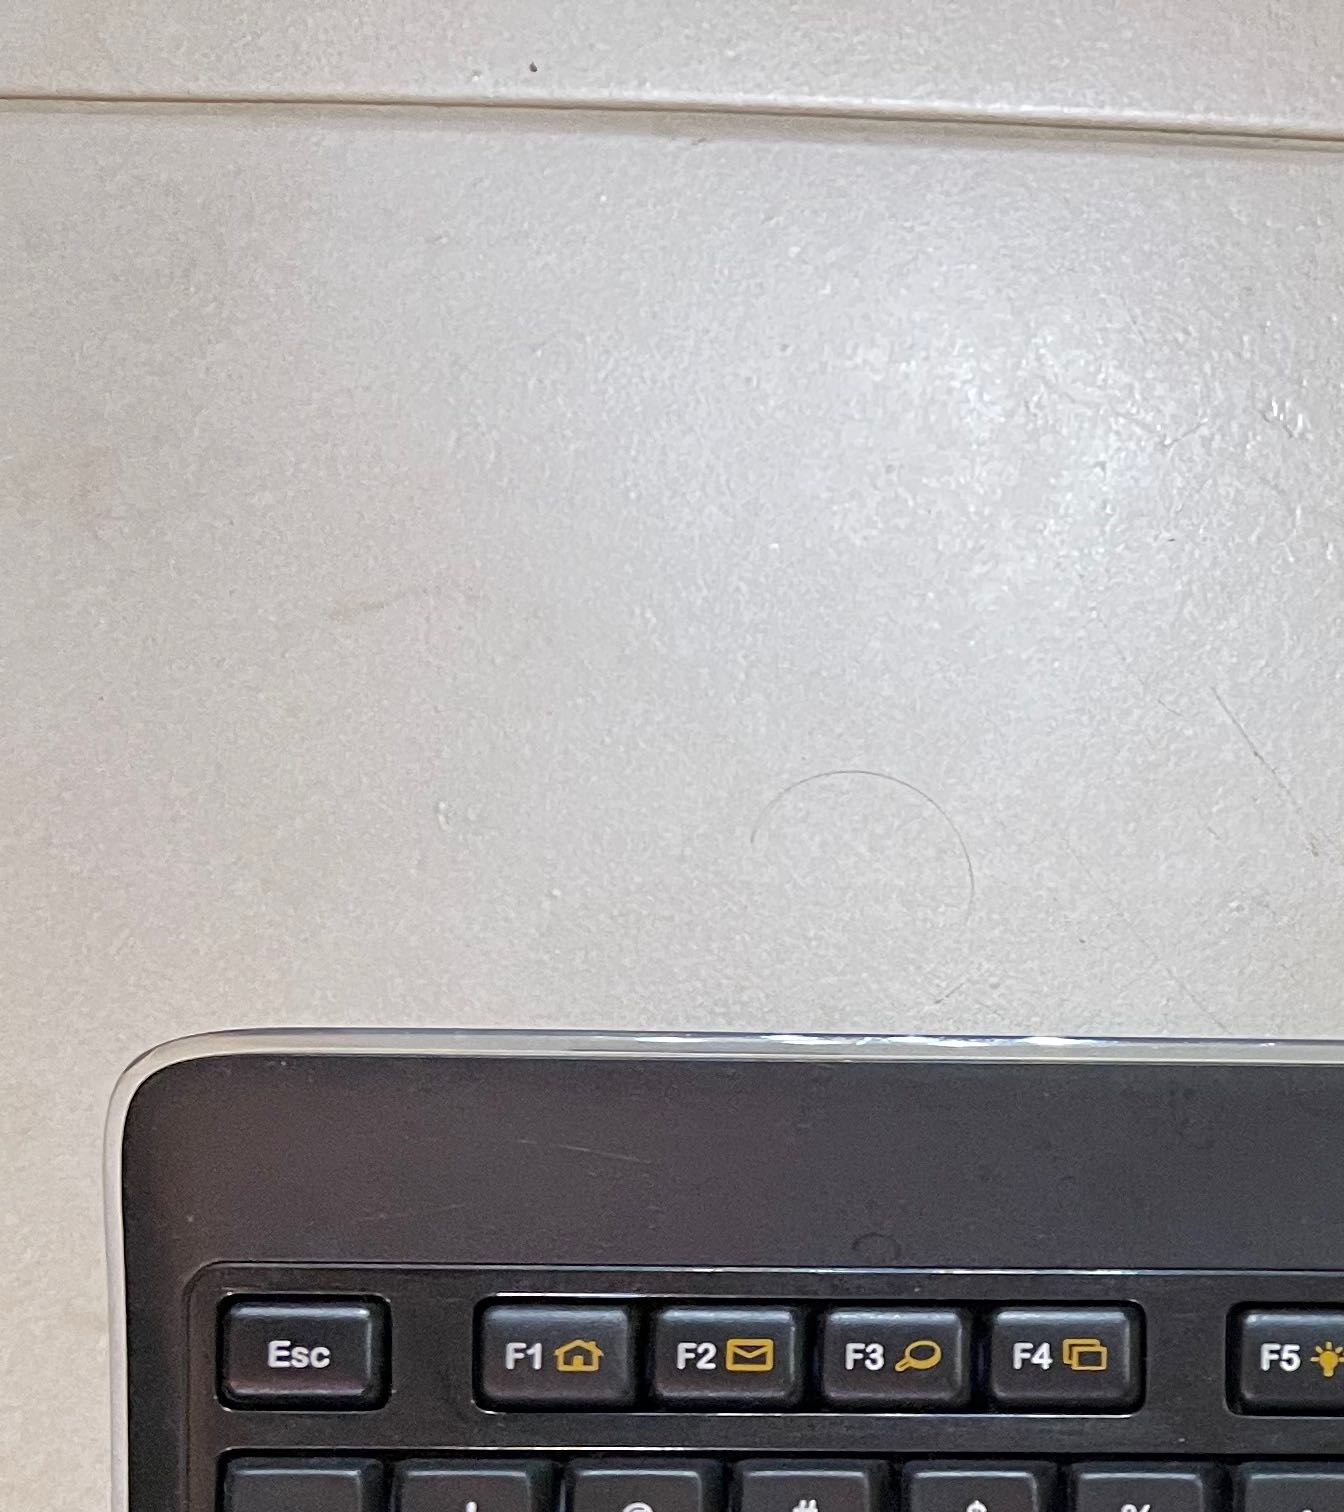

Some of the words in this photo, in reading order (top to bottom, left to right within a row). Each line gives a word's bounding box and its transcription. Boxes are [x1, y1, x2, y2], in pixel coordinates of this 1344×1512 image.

[267, 1340, 331, 1368] Esc
[505, 1342, 543, 1370] F1
[676, 1342, 717, 1370] F2
[845, 1342, 885, 1371] F3
[1013, 1342, 1053, 1370] F4
[1260, 1343, 1301, 1372] F5
